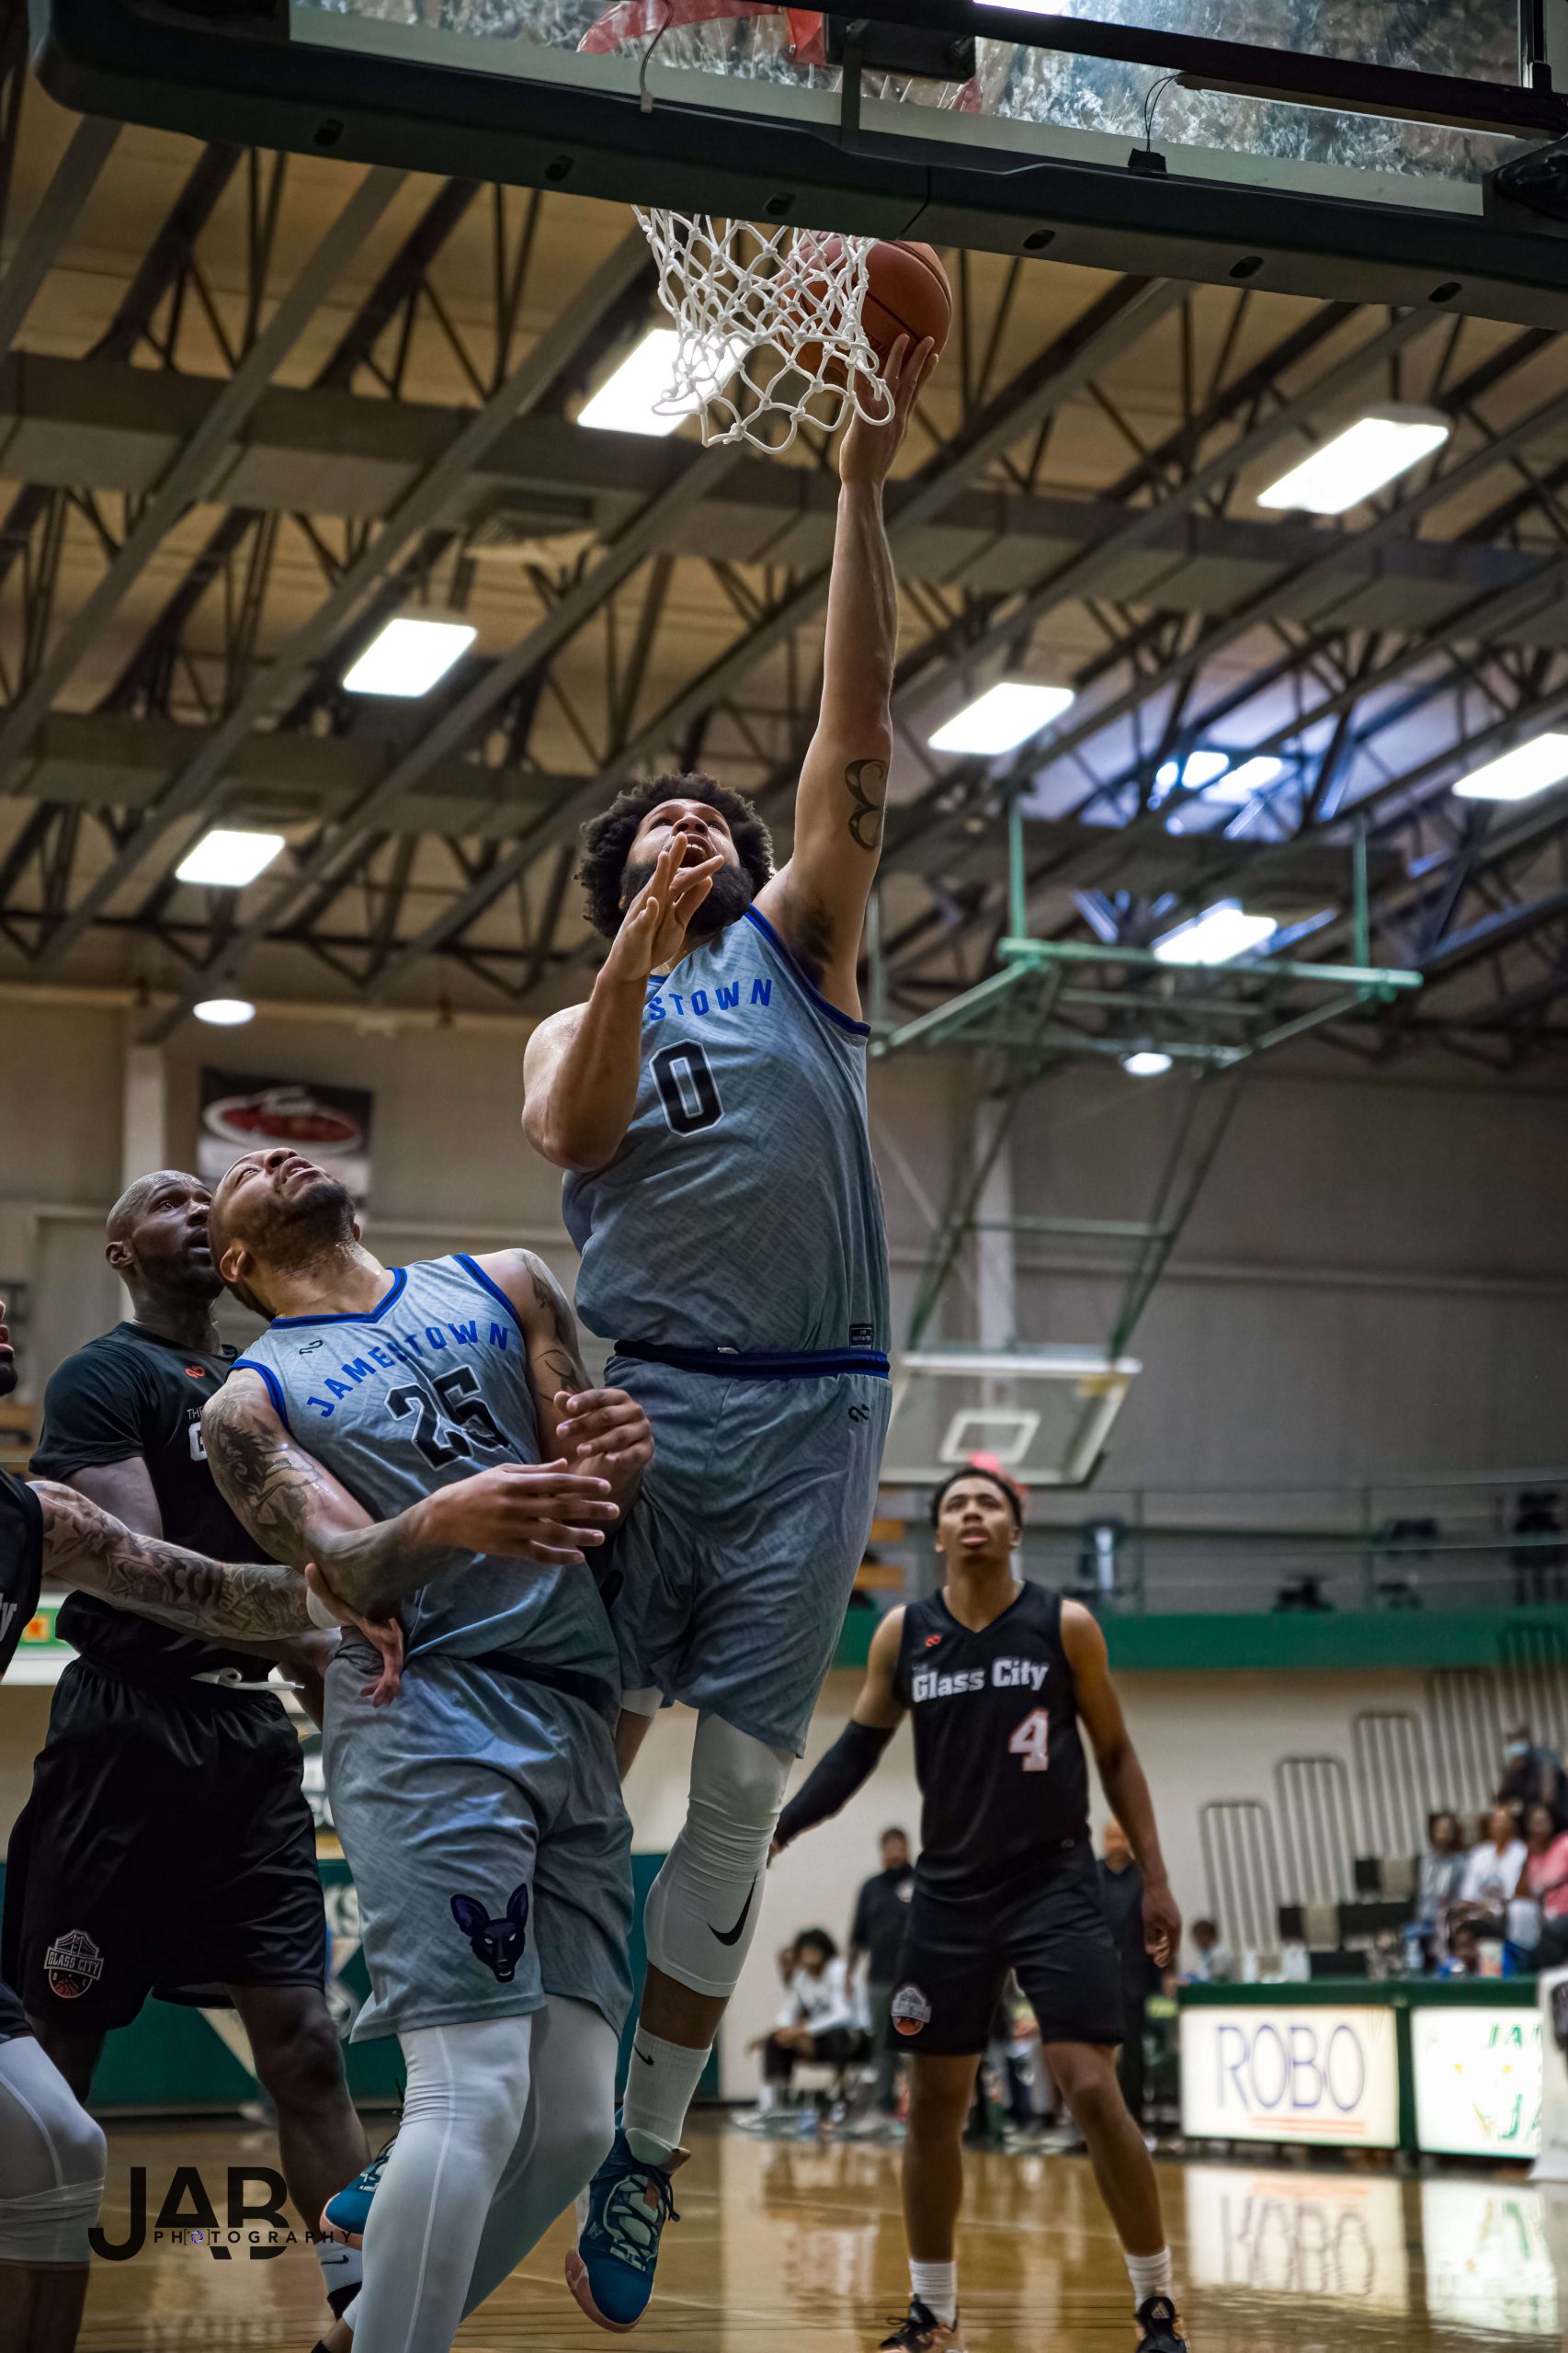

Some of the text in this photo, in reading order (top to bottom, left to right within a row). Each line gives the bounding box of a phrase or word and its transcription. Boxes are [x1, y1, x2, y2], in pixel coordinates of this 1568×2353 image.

[648, 1038, 725, 1138] 0
[383, 1364, 510, 1472] 25
[912, 1656, 1050, 1703] Glass City
[1008, 1707, 1051, 1772] 4
[48, 1951, 100, 1975] GLASS CITY
[1216, 2024, 1366, 2112] ROBO
